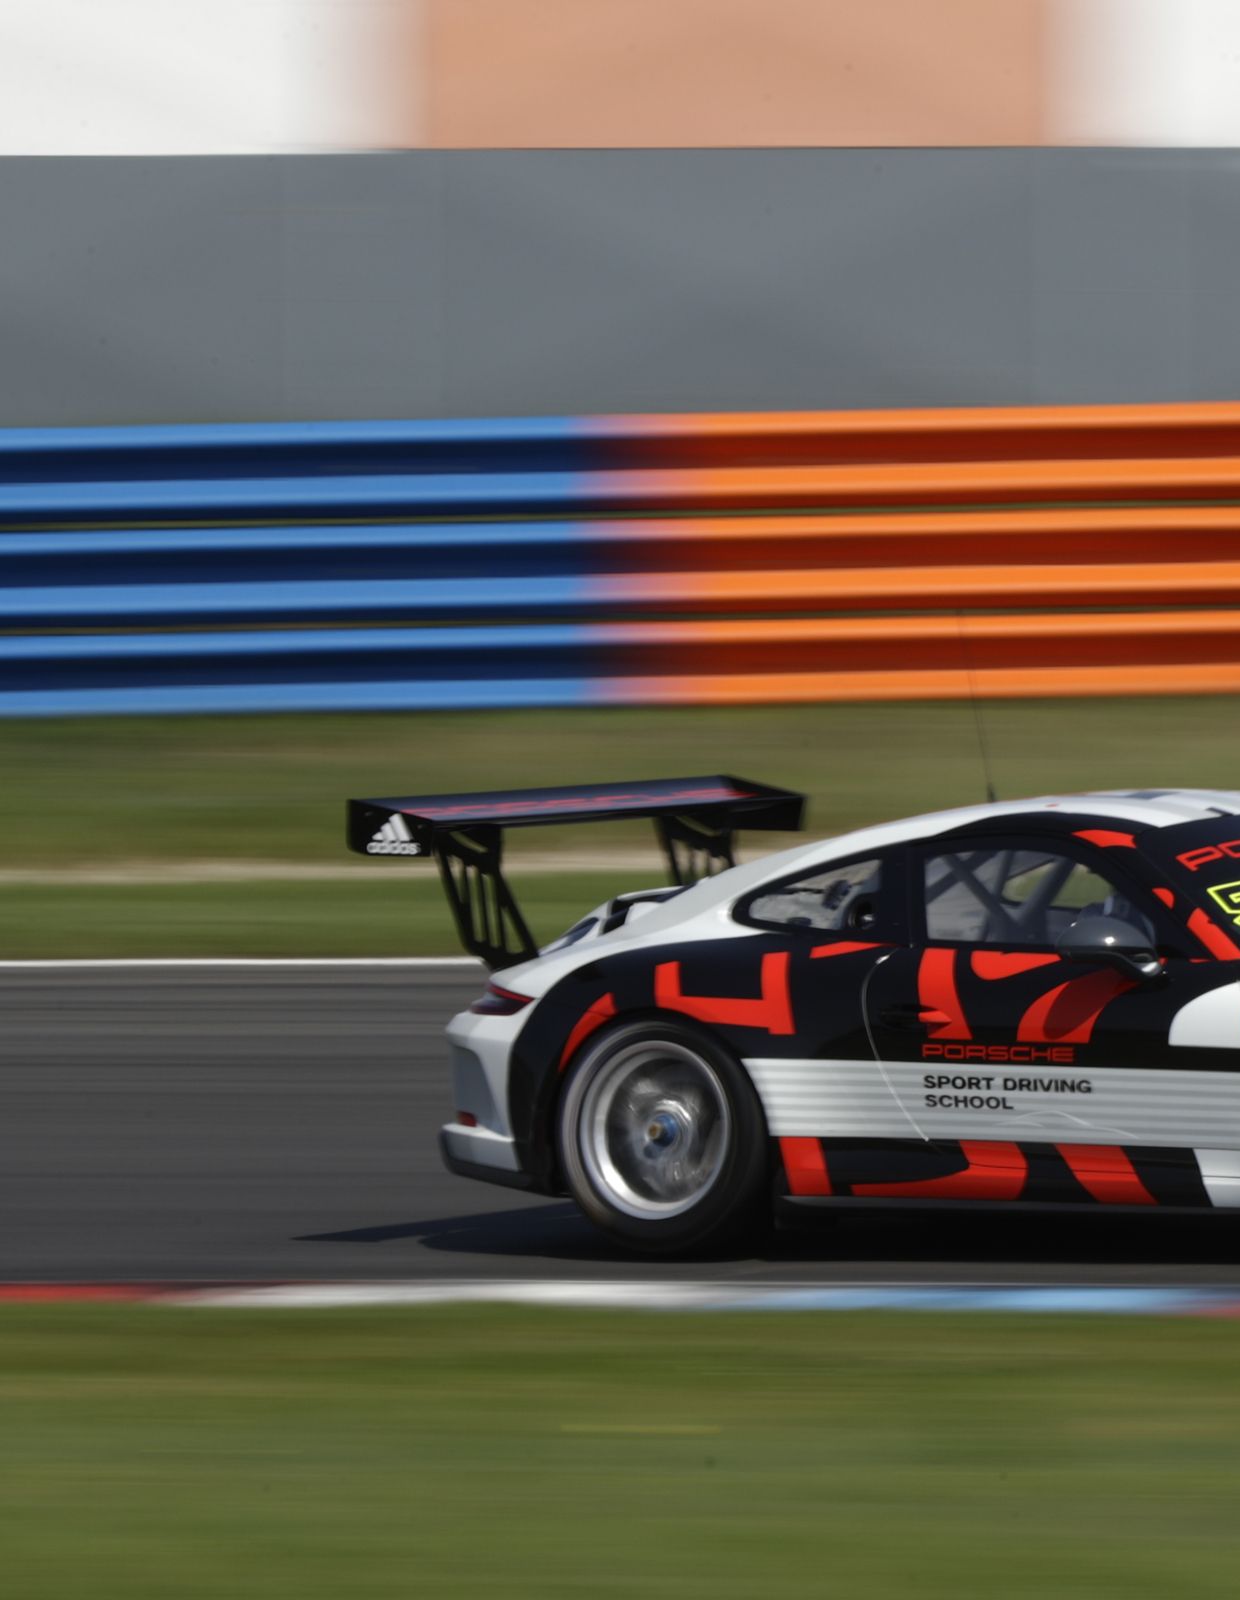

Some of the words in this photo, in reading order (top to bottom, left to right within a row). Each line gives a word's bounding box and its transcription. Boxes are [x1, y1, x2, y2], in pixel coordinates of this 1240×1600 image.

[366, 840, 421, 855] adidas
[922, 1043, 1074, 1062] PORSCHE
[923, 1075, 995, 1091] SPORT
[1003, 1077, 1092, 1094] DRIVING
[925, 1094, 1014, 1110] SCHOOL
